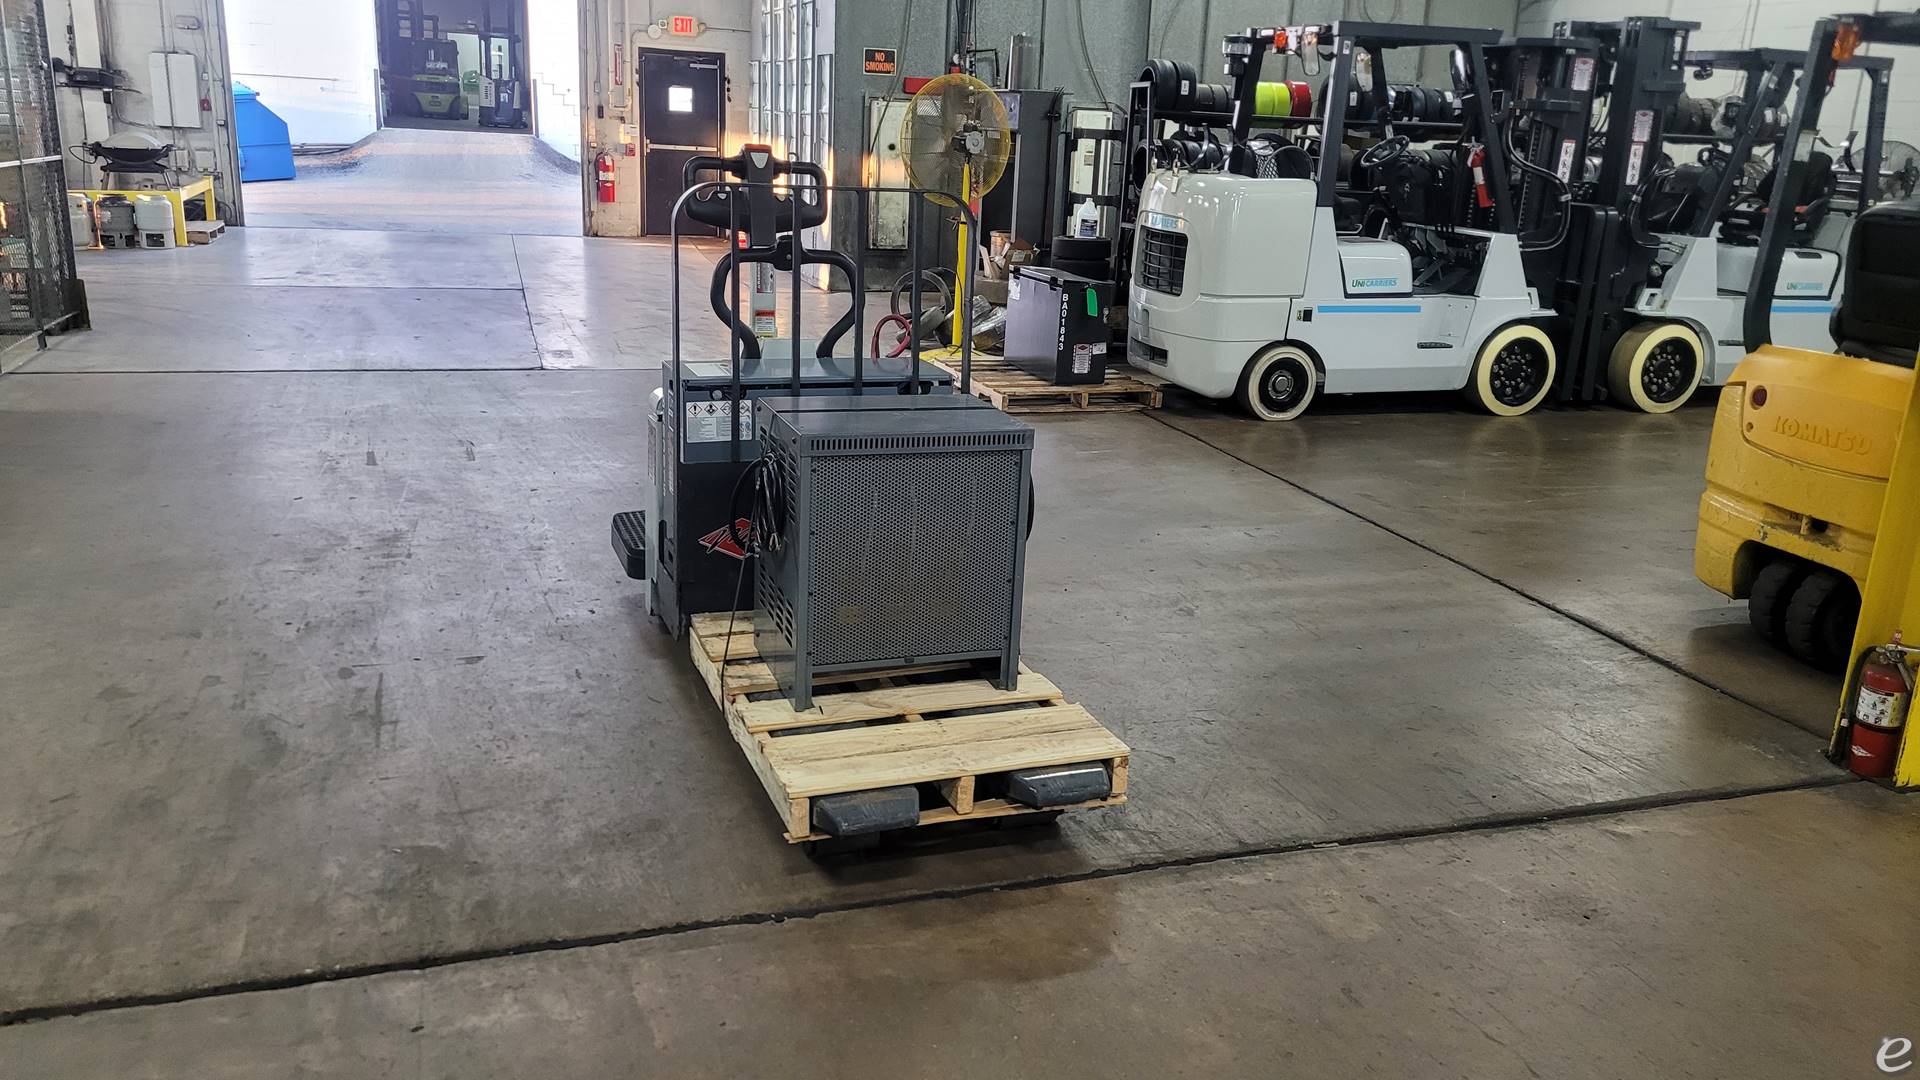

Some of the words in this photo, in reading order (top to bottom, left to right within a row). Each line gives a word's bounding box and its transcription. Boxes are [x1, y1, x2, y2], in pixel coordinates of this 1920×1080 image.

[674, 17, 693, 33] EXIT
[875, 52, 885, 61] NO
[865, 61, 895, 72] SMOKING
[1058, 293, 1069, 351] BA01843
[1774, 415, 1873, 456] KOMATSU
